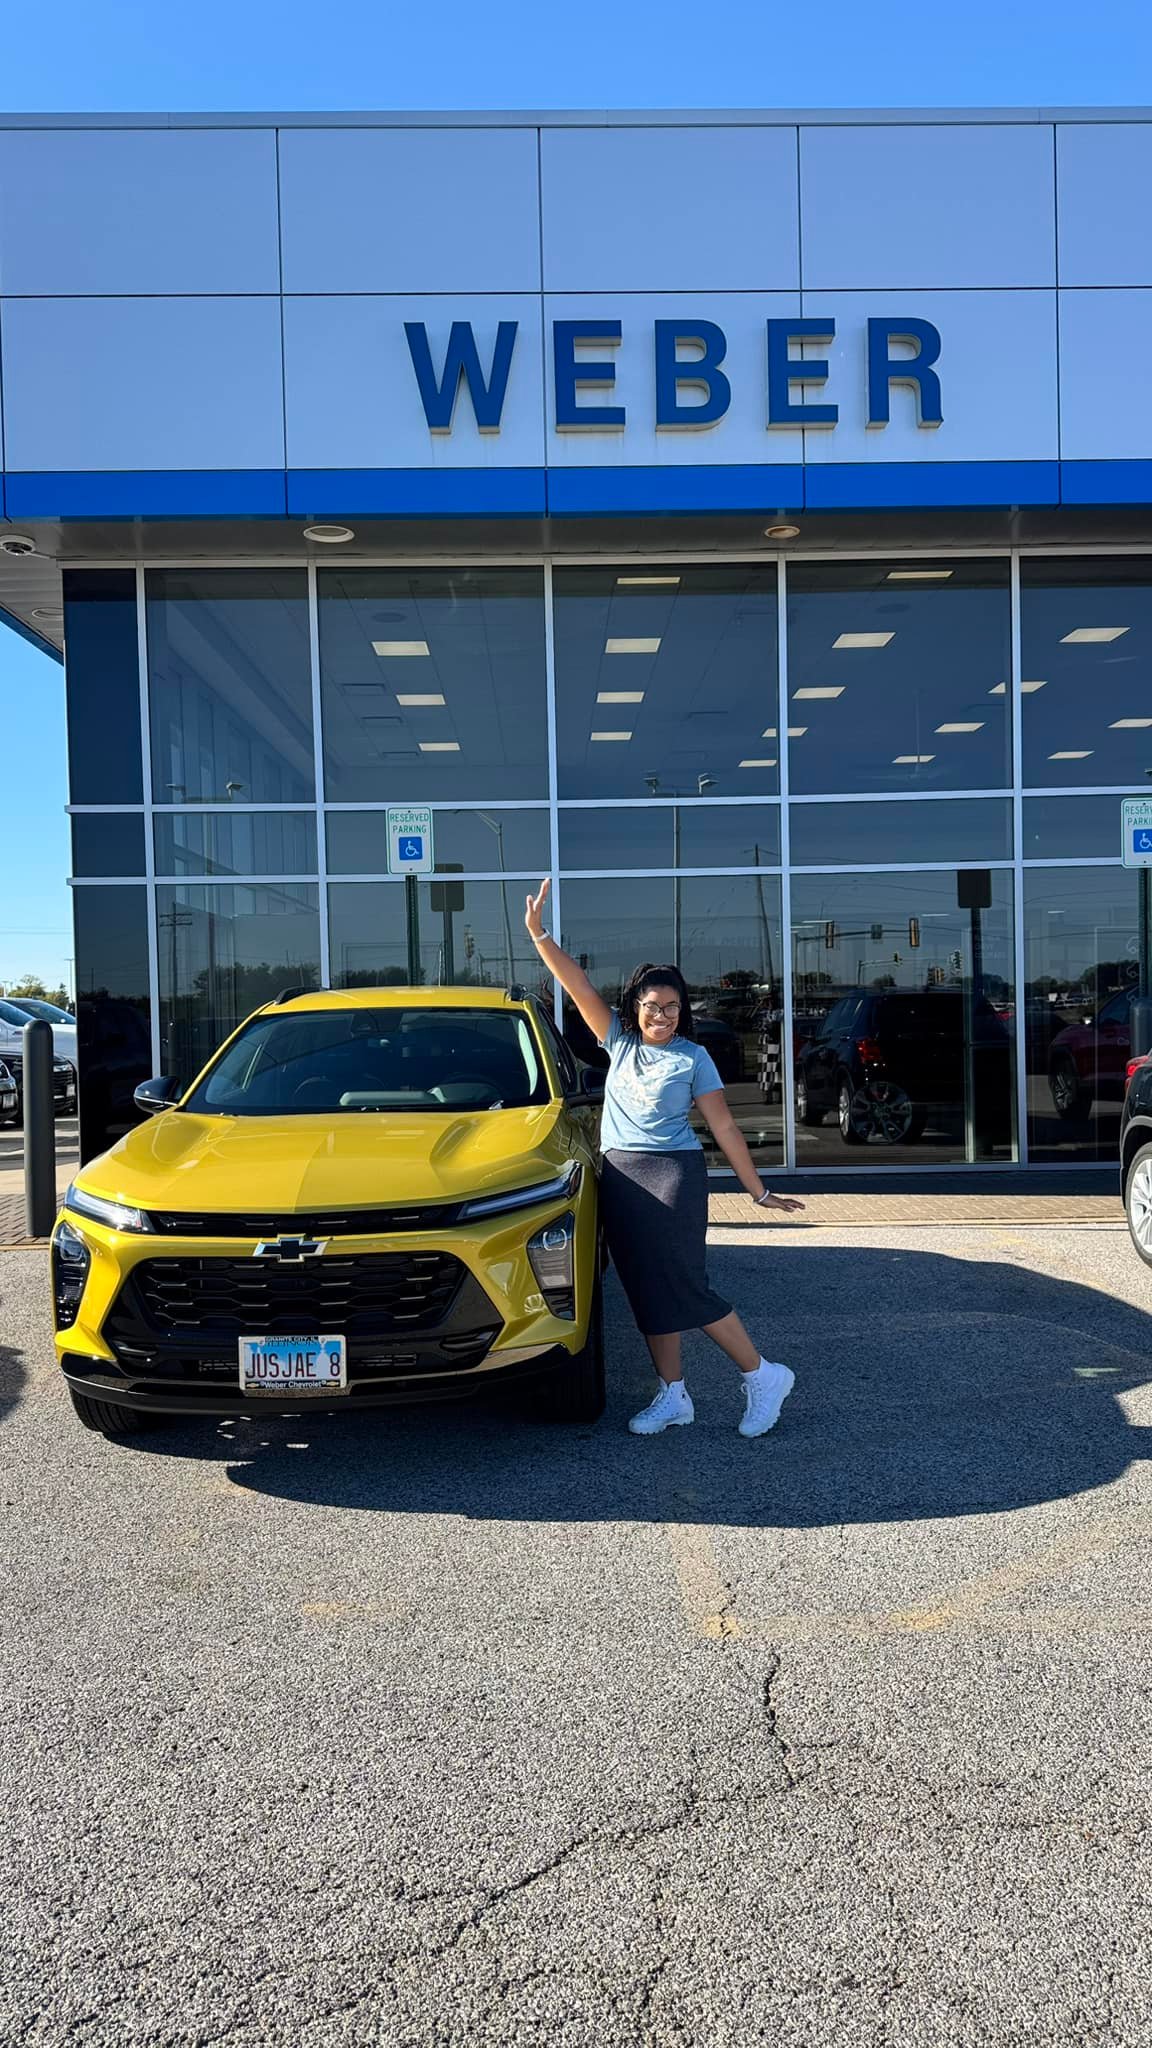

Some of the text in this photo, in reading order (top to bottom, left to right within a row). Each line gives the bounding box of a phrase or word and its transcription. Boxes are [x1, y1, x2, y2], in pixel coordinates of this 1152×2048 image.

[404, 318, 944, 432] WEBER
[390, 813, 430, 822] RESERVED
[392, 825, 427, 833] PARKING
[245, 1352, 340, 1378] JUSJAE 8
